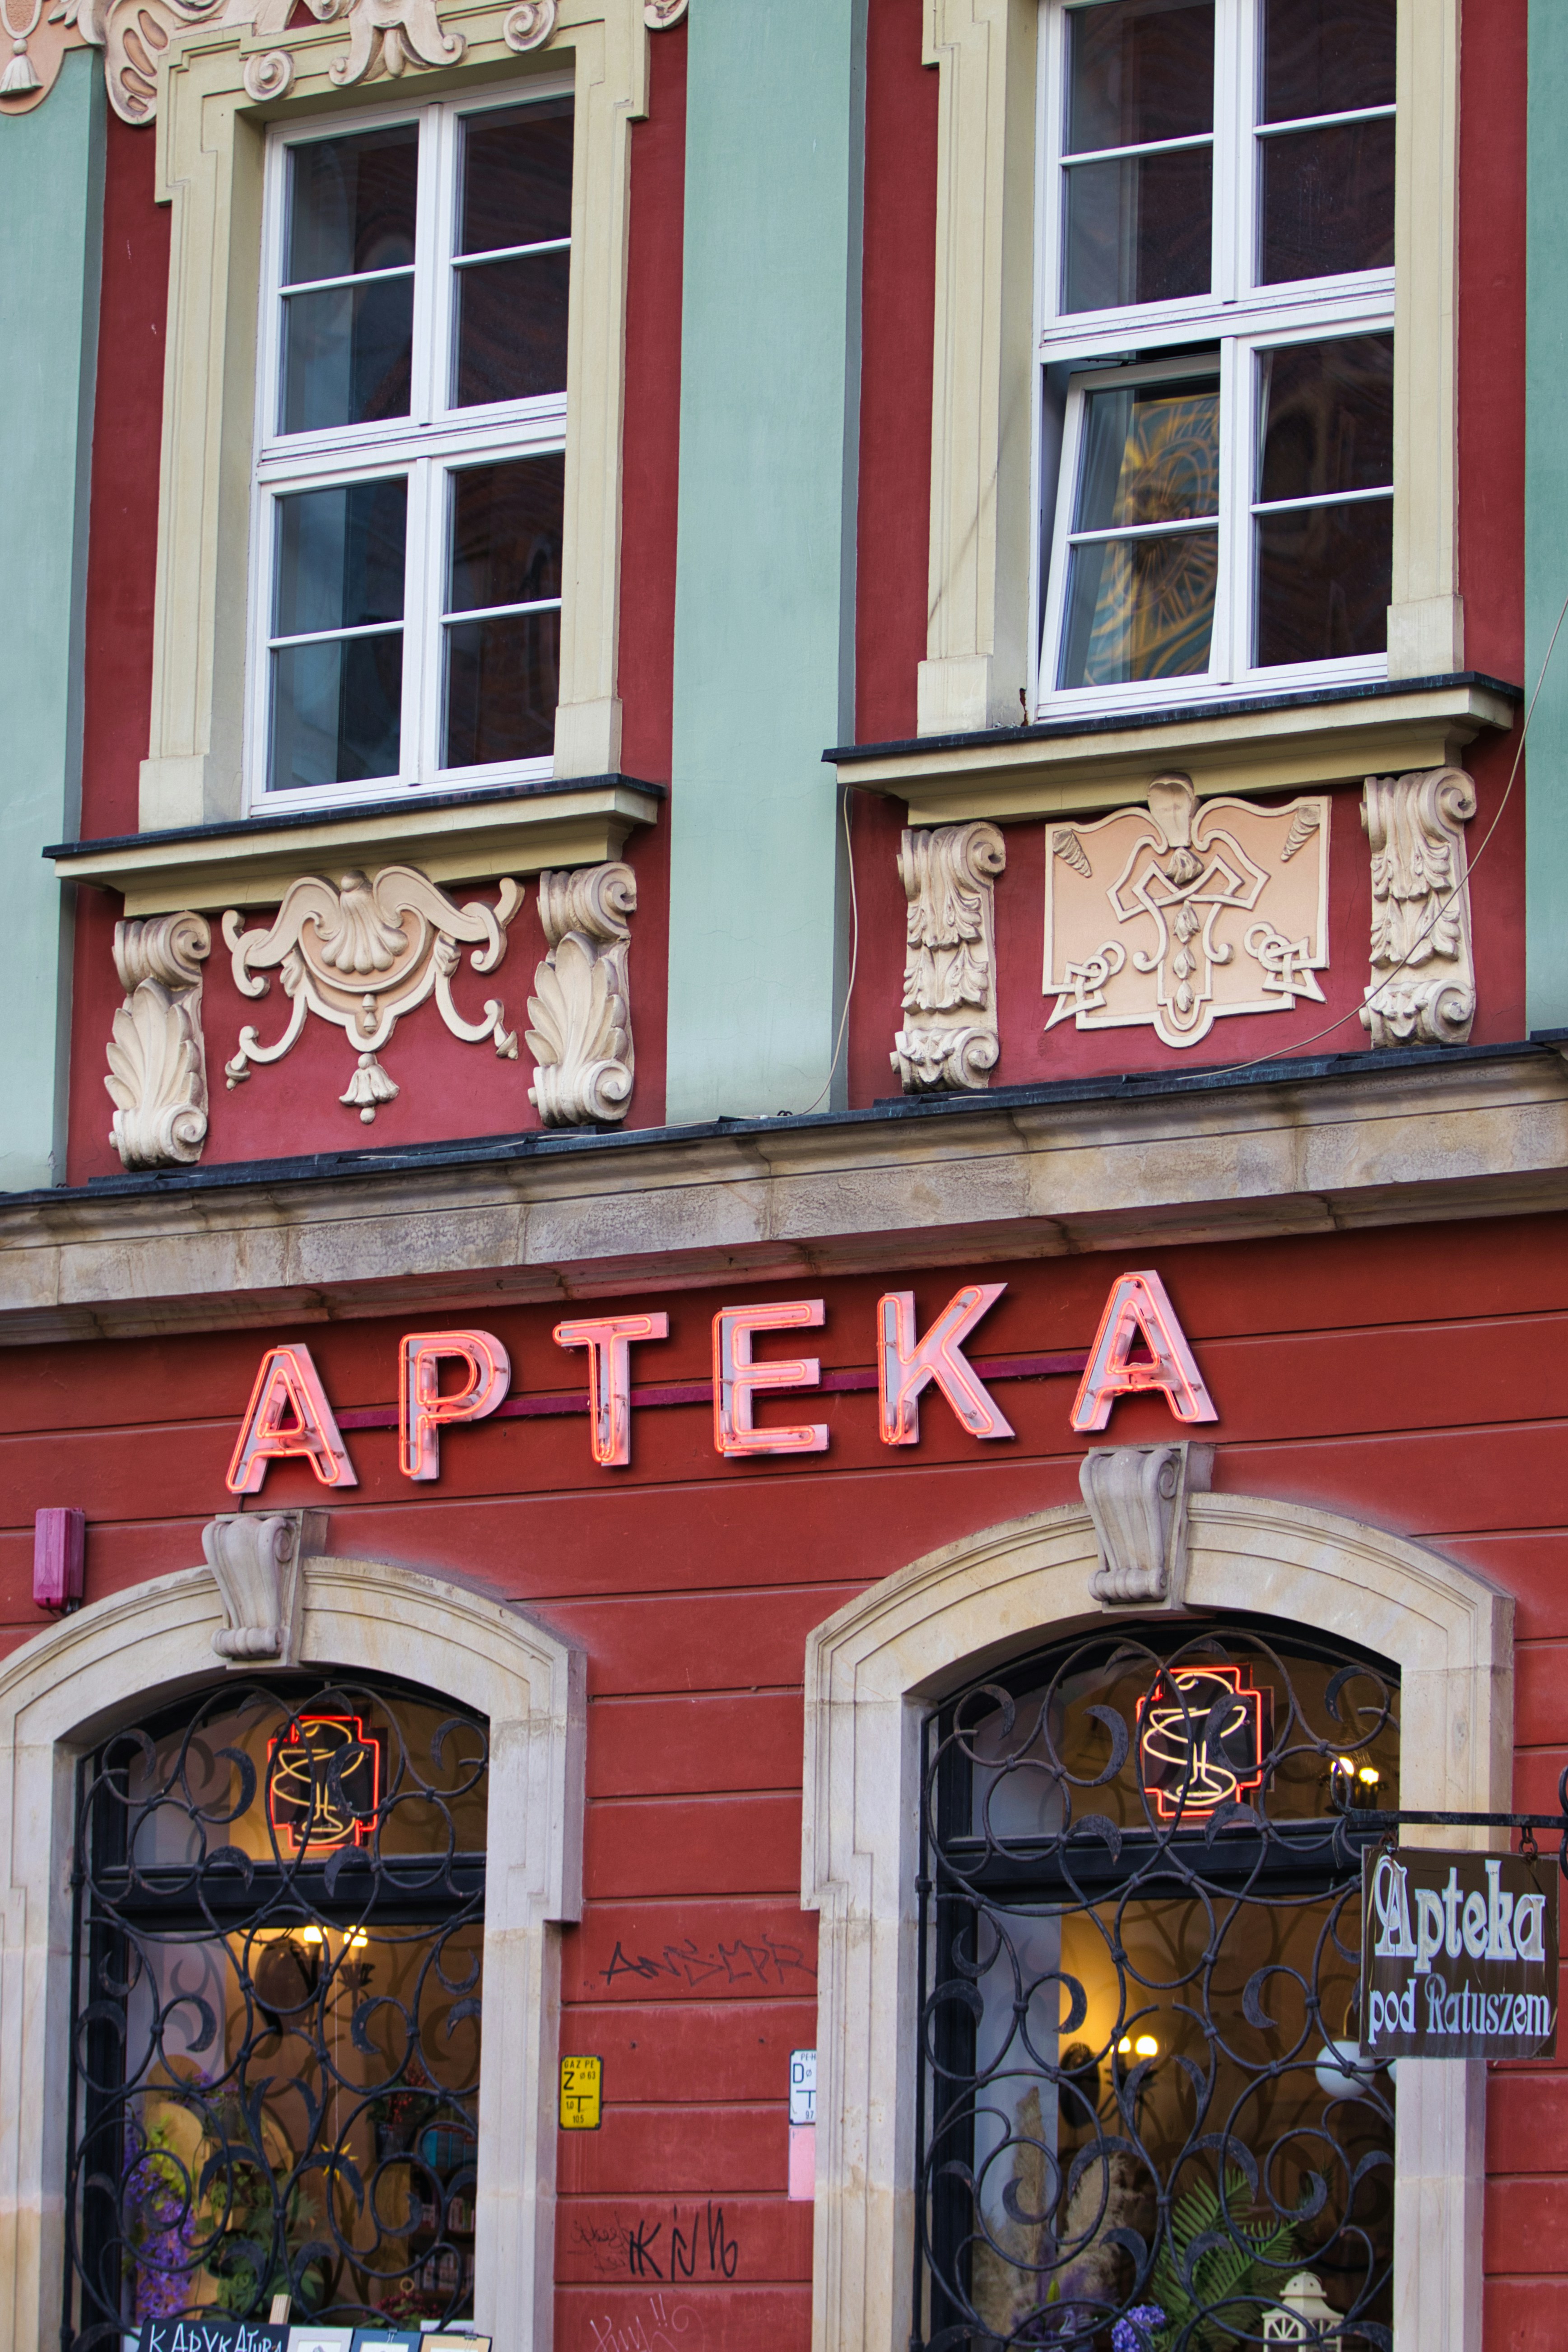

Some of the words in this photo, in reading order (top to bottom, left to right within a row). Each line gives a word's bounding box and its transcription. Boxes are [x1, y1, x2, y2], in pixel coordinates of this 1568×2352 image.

[225, 1269, 1219, 1492] APTEKA
[1374, 1855, 1546, 1973] Apteka
[1368, 1978, 1417, 2044] pod
[1424, 1972, 1550, 2036] Ratuszem
[563, 2071, 575, 2090] Z
[564, 2060, 581, 2068] GAZ
[585, 2060, 594, 2068] PE
[793, 2062, 805, 2083] D
